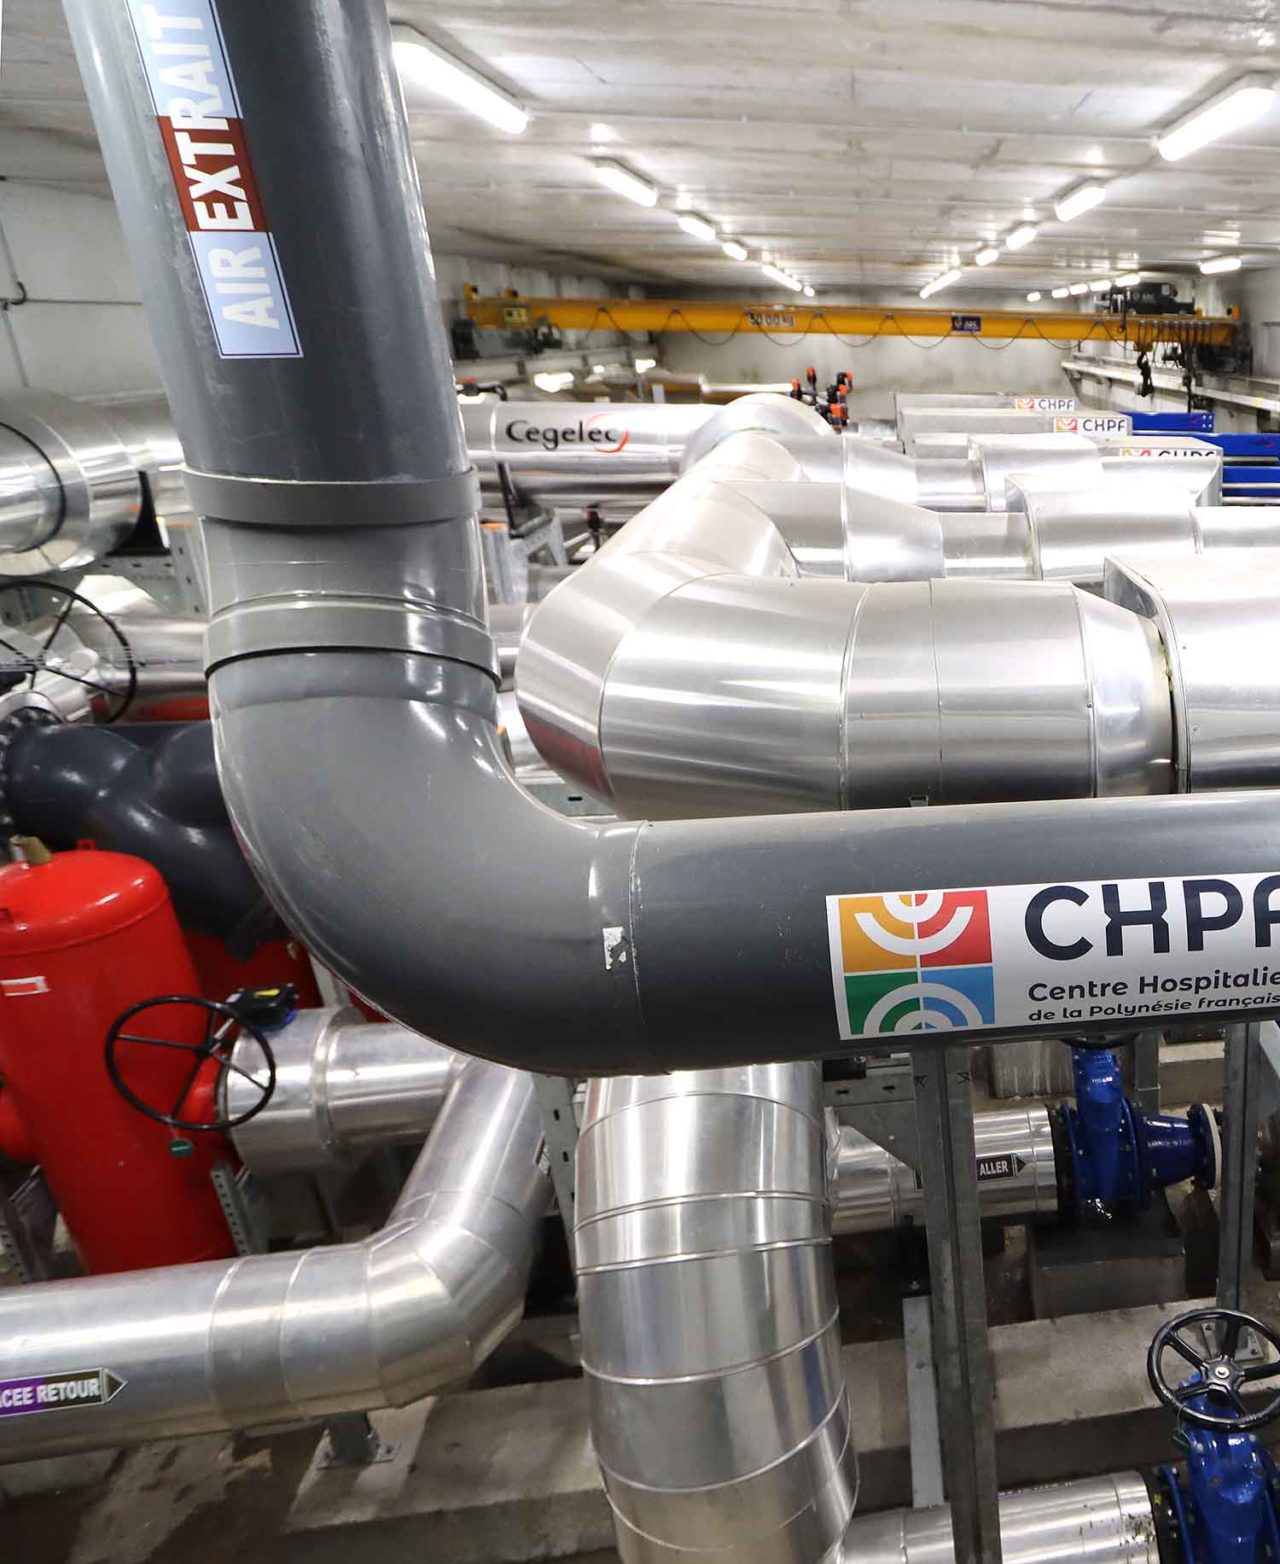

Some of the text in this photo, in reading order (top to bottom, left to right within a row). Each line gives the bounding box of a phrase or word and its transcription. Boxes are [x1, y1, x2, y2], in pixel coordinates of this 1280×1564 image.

[142, 4, 281, 330] AIR EXTRAIT
[1038, 399, 1073, 411] CHPF
[505, 419, 618, 452] Cegelec
[1082, 418, 1126, 432] CHPF
[1028, 980, 1129, 1002] Centre
[1028, 1009, 1056, 1022] de
[1062, 1007, 1083, 1019] la
[1089, 1000, 1192, 1017] Polynésie
[979, 1160, 1009, 1177] ALLER
[0, 1378, 101, 1409] CEE RETOUR
